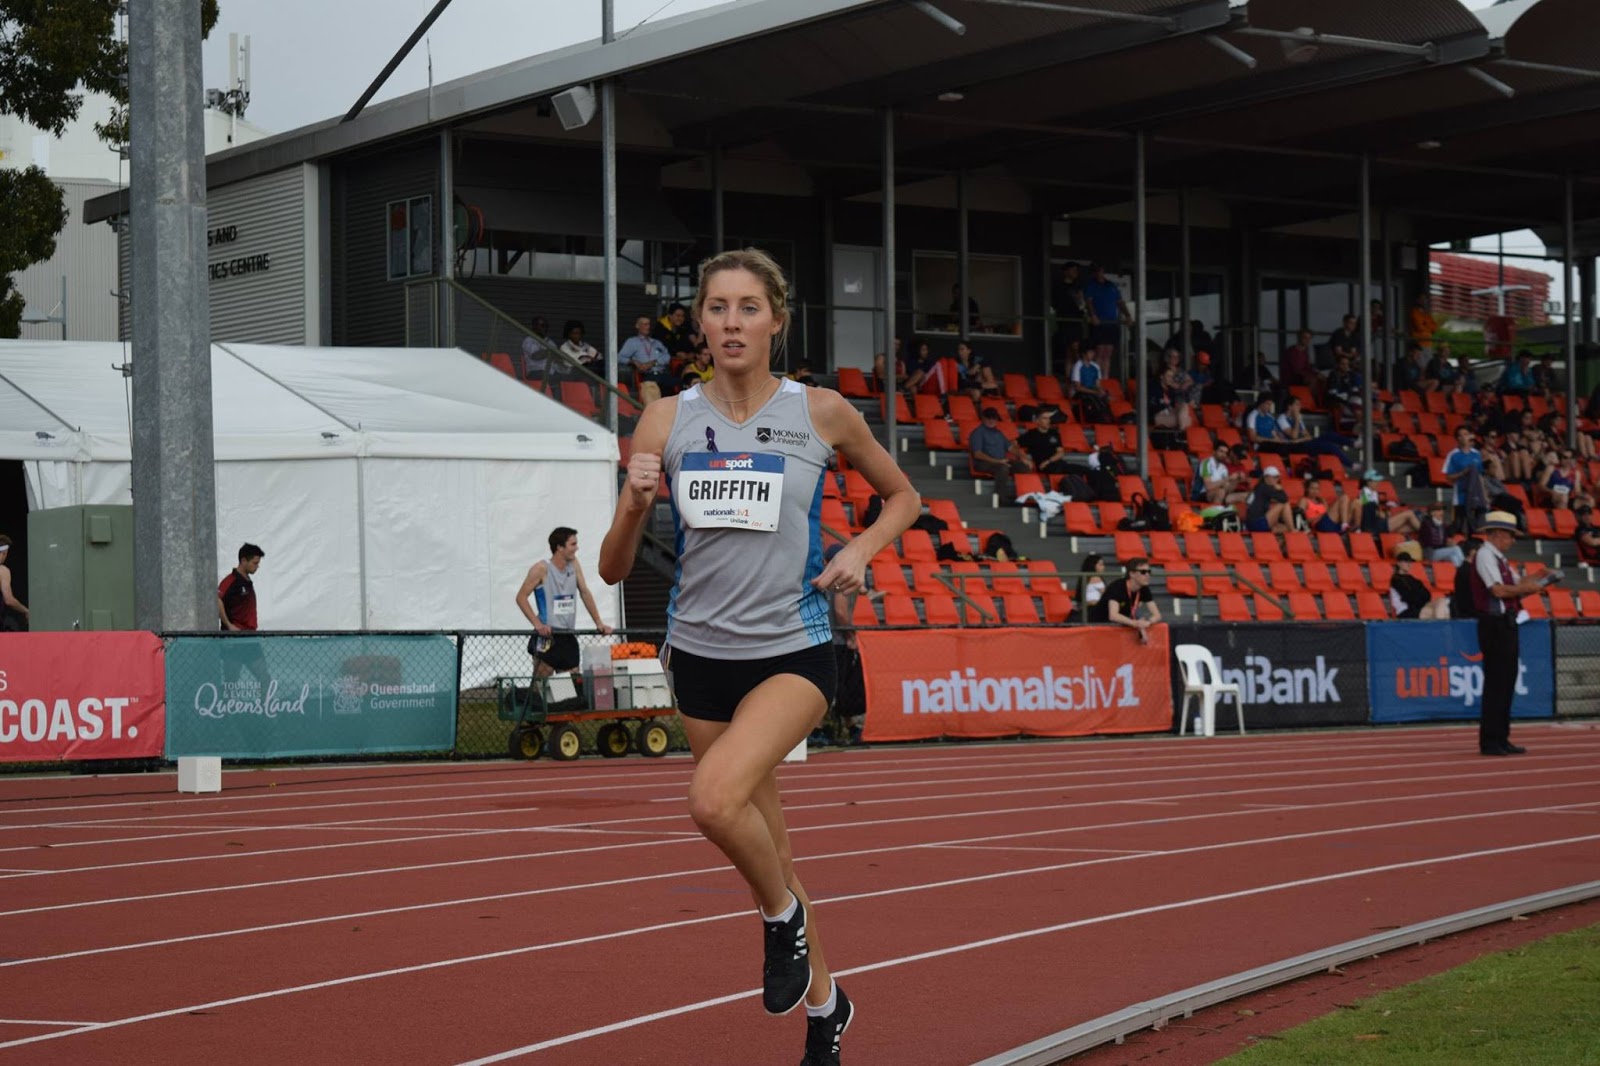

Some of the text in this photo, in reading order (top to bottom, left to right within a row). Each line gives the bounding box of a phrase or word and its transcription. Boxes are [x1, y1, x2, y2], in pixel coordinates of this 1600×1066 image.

[215, 226, 237, 244] AND
[231, 253, 270, 276] CENTRE
[772, 436, 808, 448] University
[773, 429, 810, 440] MONASH
[709, 458, 753, 470] unisport
[689, 480, 770, 502] GRIFFITH
[223, 681, 262, 690] TOURISM
[1396, 656, 1529, 706] unispt
[230, 689, 262, 698] EVENTS
[371, 682, 435, 697] Queensland
[902, 664, 1140, 714] nationalsdiv1
[195, 680, 309, 718] Queensland
[371, 697, 435, 710] Government
